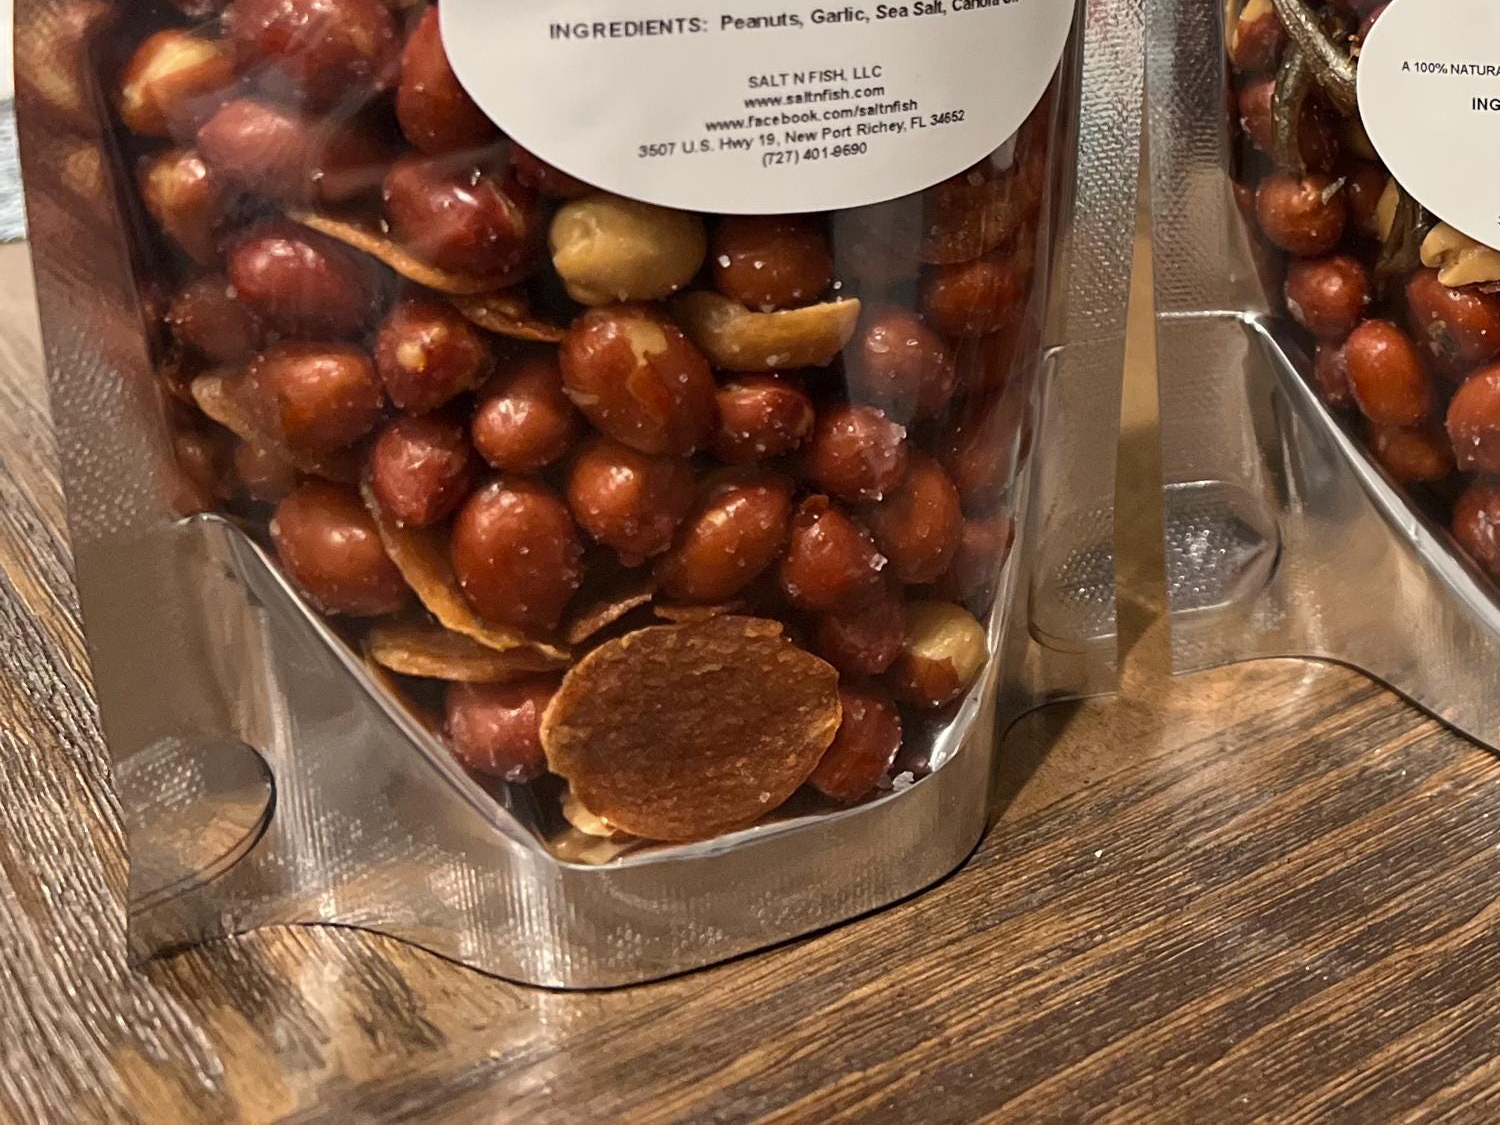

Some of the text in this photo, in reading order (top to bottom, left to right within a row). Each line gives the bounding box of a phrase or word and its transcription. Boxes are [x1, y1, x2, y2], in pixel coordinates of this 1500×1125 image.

[549, 17, 707, 39] INGREDIENTS:
[721, 12, 804, 31] Peanuts,
[810, 7, 870, 24] Garlic,
[875, 4, 908, 19] Sea
[913, 0, 947, 16] Salt,
[748, 65, 882, 88] SALT N FISH, LLC
[1402, 61, 1410, 72] A
[1414, 62, 1448, 74] 100%
[744, 87, 884, 108] www.saltnfish.com
[705, 99, 917, 131] www.facebook.com/saltnfish
[638, 109, 965, 158] 3507 U.S. Hwy 19, New Port Richey, FL 34652
[762, 150, 799, 168] (727)
